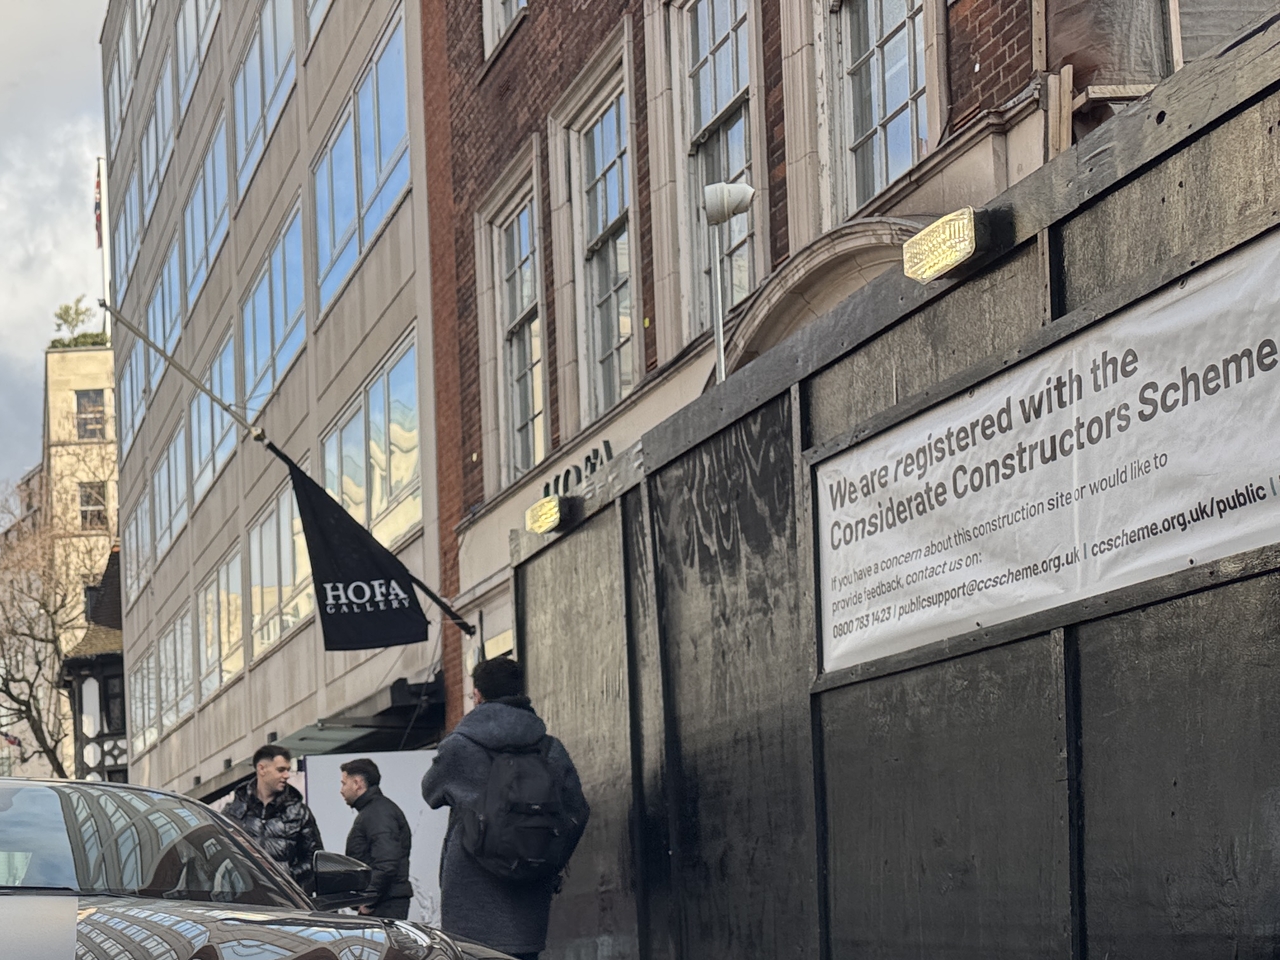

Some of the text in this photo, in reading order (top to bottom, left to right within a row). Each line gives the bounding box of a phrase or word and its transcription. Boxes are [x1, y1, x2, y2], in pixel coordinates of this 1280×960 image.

[829, 348, 1139, 511] We are registered with the
[830, 338, 1279, 551] Considerate Constructors Scheme
[322, 579, 408, 605] HOFA
[831, 452, 1169, 592] If you have a concern about this construction site or would like to
[831, 551, 983, 616] provide feedback, contact us on:
[832, 620, 854, 639] 0800
[854, 613, 870, 632] 783
[871, 606, 892, 626] 1423
[897, 546, 1081, 621] publicsupport@ccscheme.org.uk
[1091, 482, 1267, 558] ccscheme.org.uk/public
[326, 597, 411, 614] GALLERY
